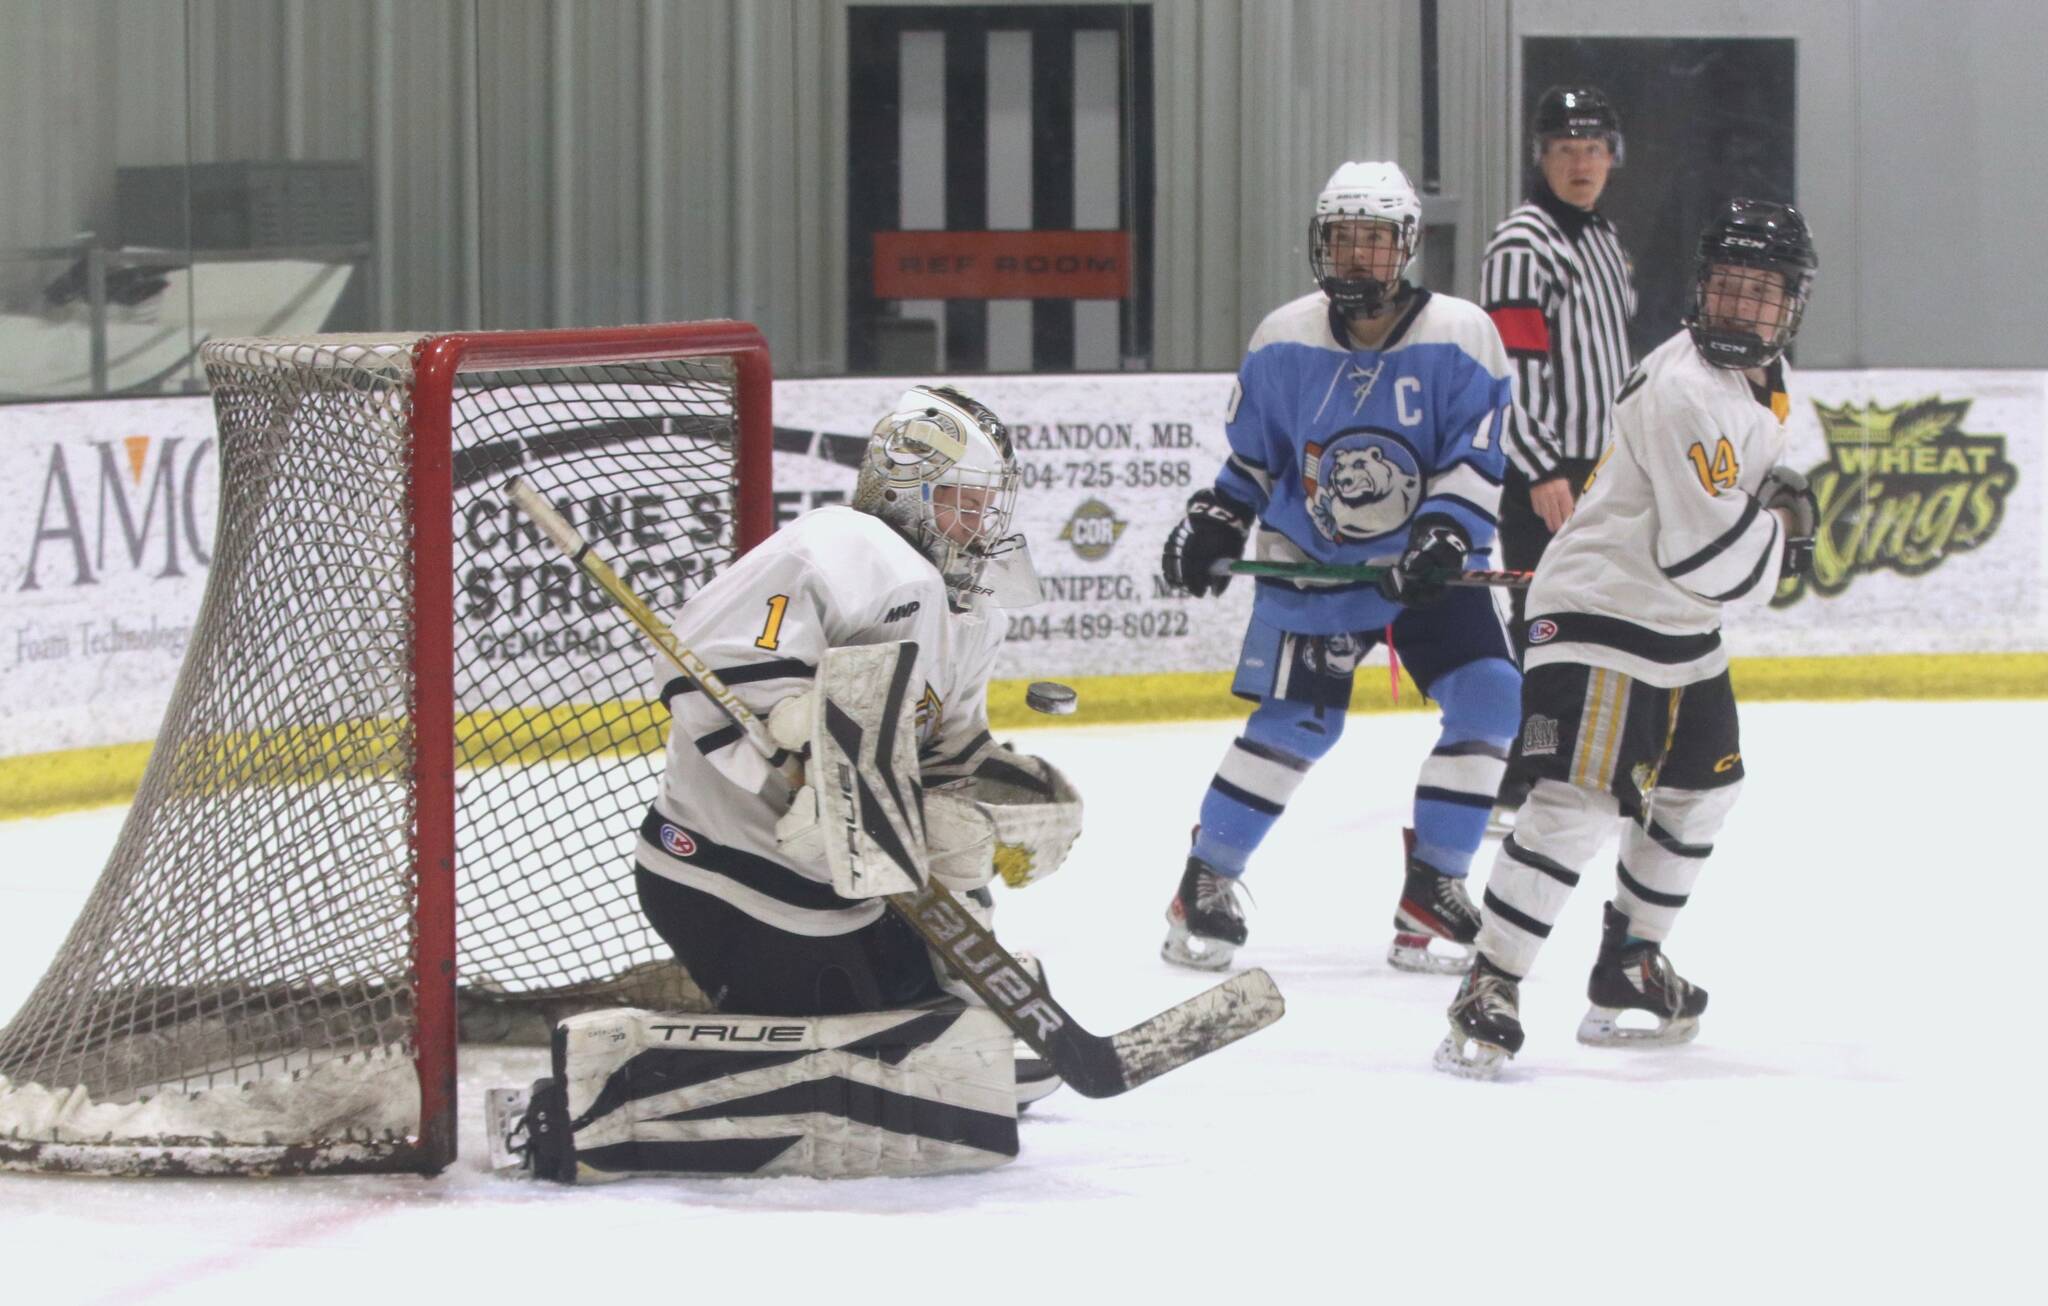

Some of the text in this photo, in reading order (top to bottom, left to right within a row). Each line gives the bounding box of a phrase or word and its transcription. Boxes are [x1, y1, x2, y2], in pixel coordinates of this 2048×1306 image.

[899, 255, 1117, 273] REF ROOM
[1394, 376, 1422, 427] C
[1152, 423, 1201, 449] MB.
[1687, 434, 1738, 497] 14
[1836, 446, 1996, 474] WHEAT
[1021, 461, 1193, 489] 04-725-3588
[1073, 518, 1115, 546] COR
[1812, 471, 2009, 588] Kings
[464, 556, 718, 622] STRUCT
[1038, 573, 1141, 602] NNIPEG,
[755, 593, 790, 651] 1
[1005, 611, 1190, 641] 204-489-8022
[649, 1025, 806, 1042] TRUE
